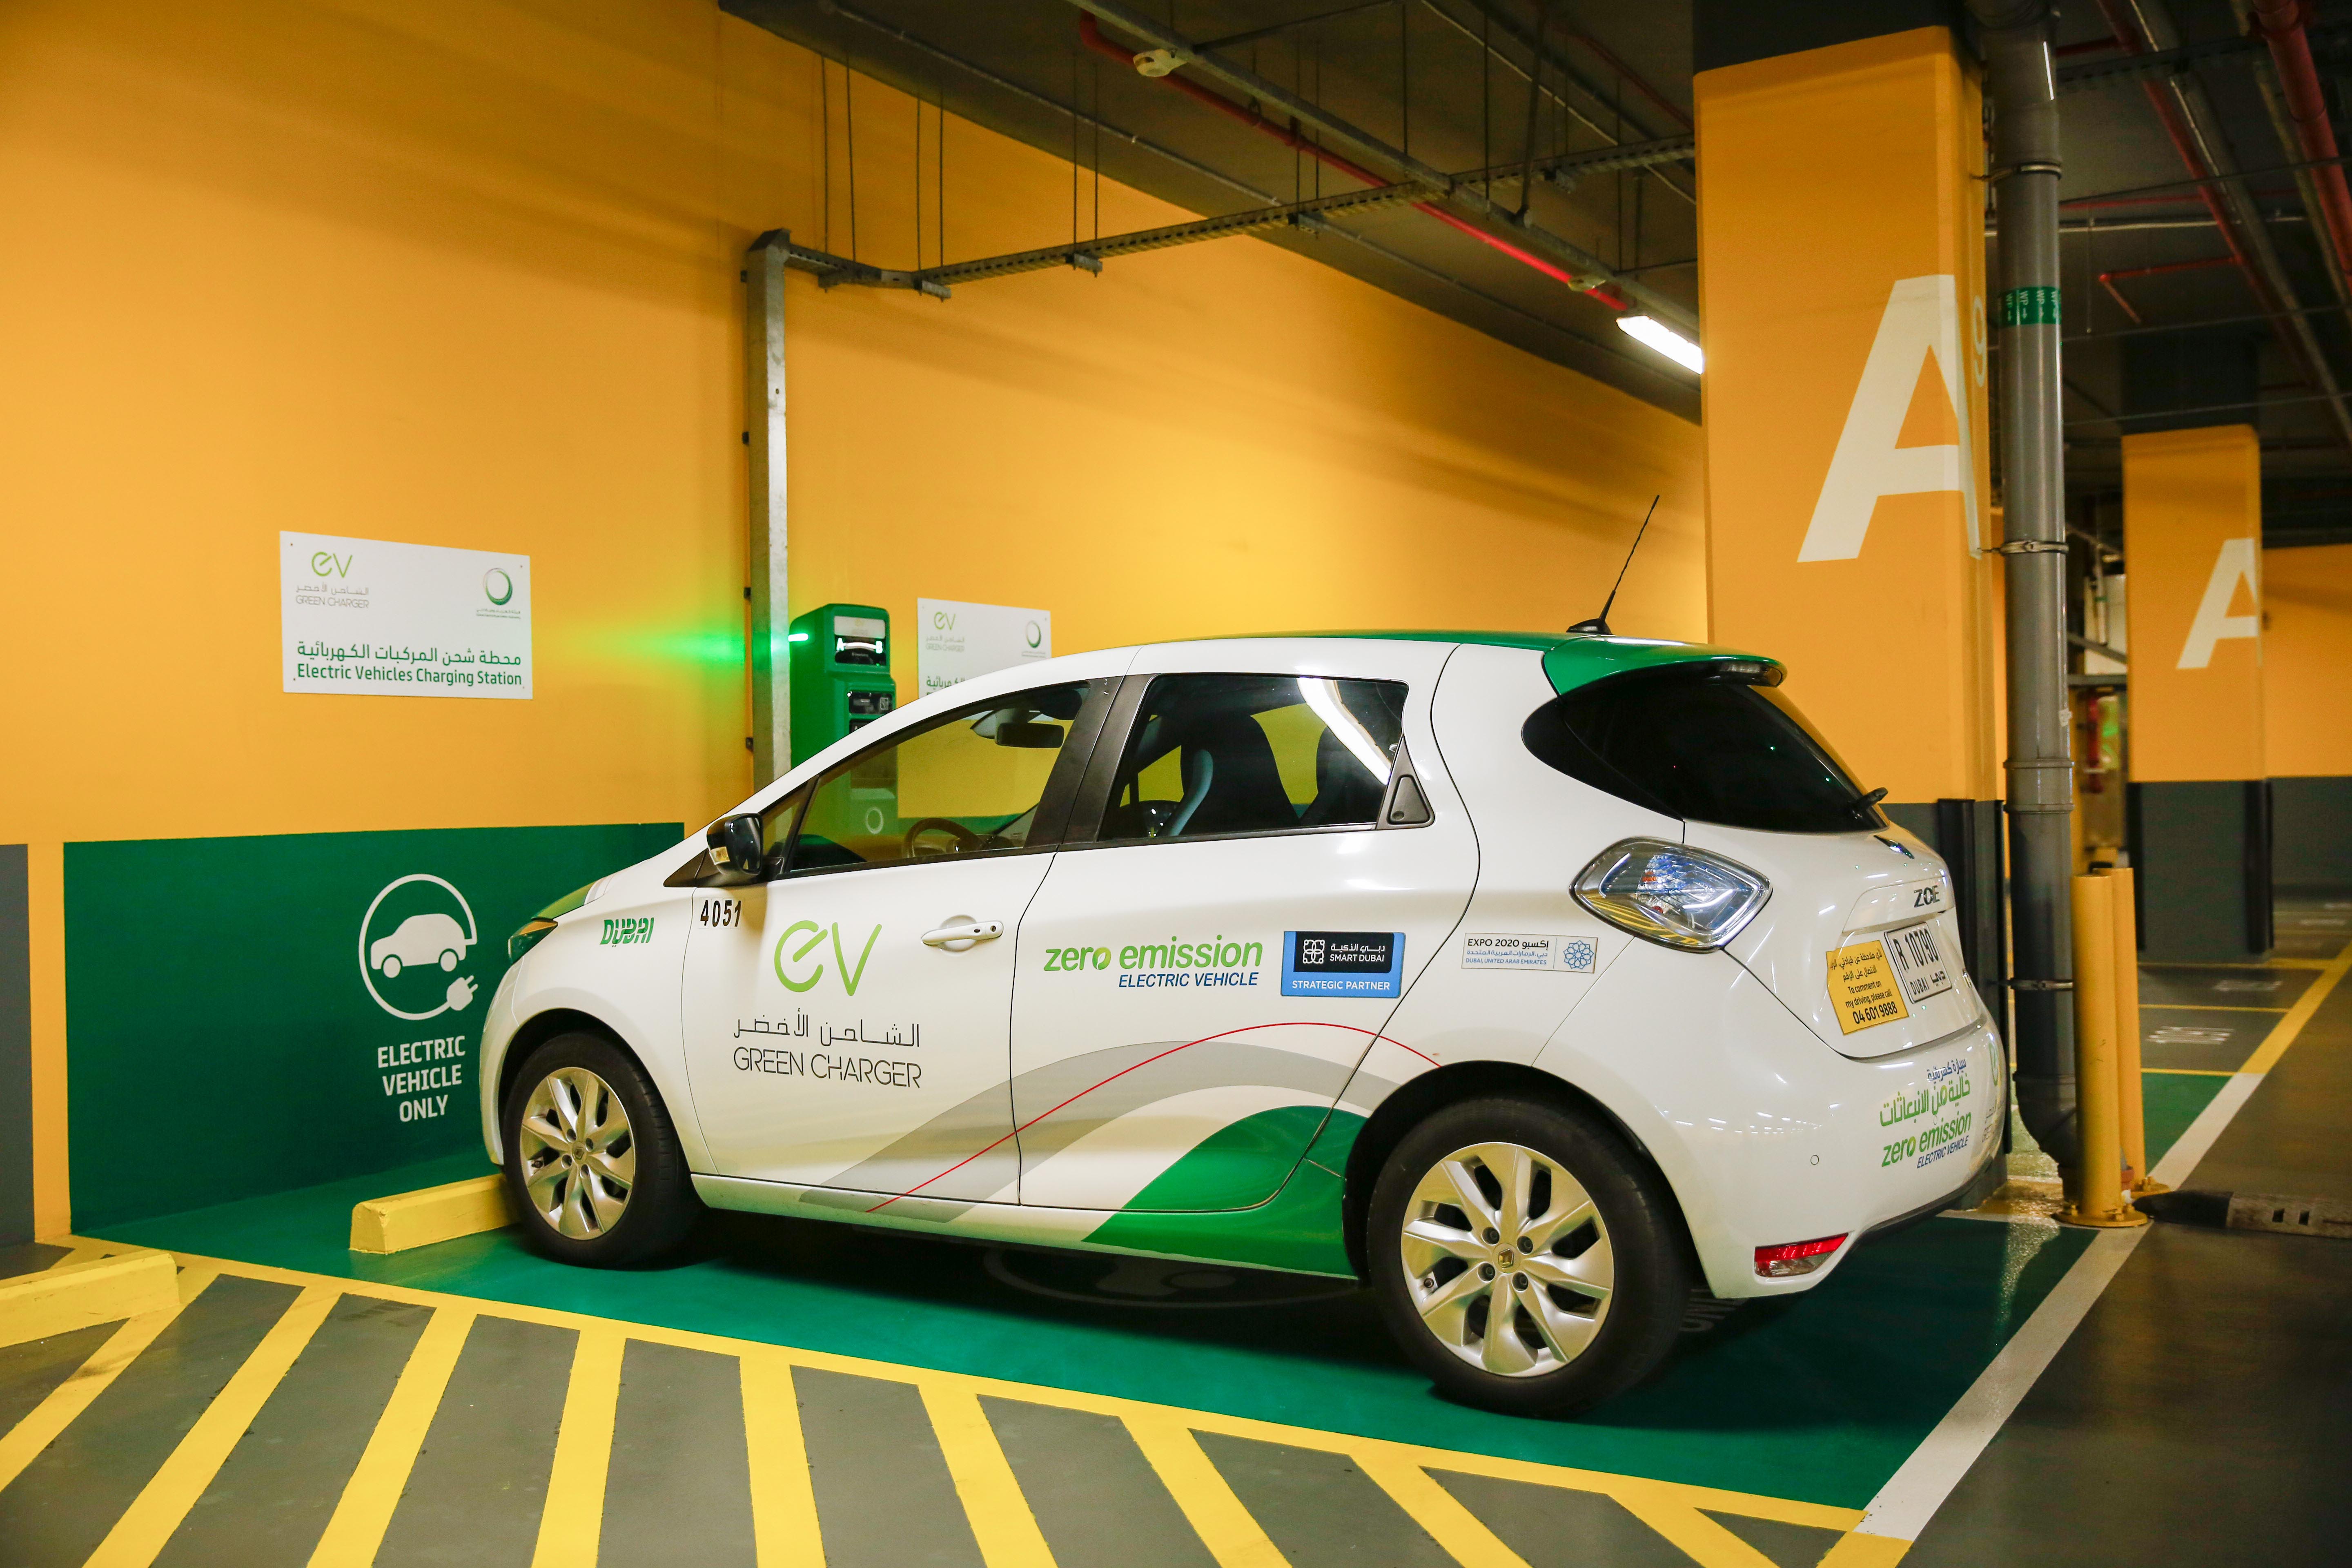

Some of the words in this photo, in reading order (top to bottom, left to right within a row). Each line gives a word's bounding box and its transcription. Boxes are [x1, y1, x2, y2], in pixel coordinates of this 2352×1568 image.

[1797, 274, 1982, 561] A
[296, 595, 325, 605] GREEN
[327, 597, 369, 608] CHARGER
[2176, 538, 2263, 670] A
[298, 641, 369, 661] الكهربائية
[375, 645, 437, 664] المركبات
[443, 648, 474, 666] شحن
[480, 650, 521, 665] محطة
[298, 663, 352, 679] Electric
[355, 665, 412, 681] Vehicles
[416, 668, 473, 686] Charging
[478, 671, 521, 685] Station
[1914, 885, 1940, 908] ZOE
[700, 900, 742, 927] 4051
[1043, 946, 1111, 971] zero
[1119, 935, 1263, 970] emission
[1331, 943, 1358, 953] الذكية
[1360, 945, 1385, 953] دبي
[1522, 940, 1549, 951] إكسبو
[1893, 938, 1909, 971] R
[1904, 928, 1938, 967] 10790
[1119, 973, 1189, 988] ELECTRIC
[1194, 972, 1259, 986] VEHICLE
[1292, 980, 1343, 989] STRATEGIC
[1346, 981, 1390, 990] PARTNER
[1855, 981, 1876, 993] comment
[1910, 977, 1929, 995] DUBAI
[1845, 1000, 1854, 1008] my
[1854, 996, 1872, 1005] driving,
[1871, 992, 1885, 1003] please
[1884, 989, 1893, 998] call
[734, 1007, 809, 1038] الأخضر
[1853, 1010, 1865, 1024] 04
[1865, 1006, 1880, 1021] 601
[1878, 1001, 1898, 1017] 9888
[820, 1019, 920, 1047] الشاحن
[378, 1036, 466, 1068] ELECTRIC
[734, 1046, 804, 1077] GREEN
[811, 1054, 922, 1089] CHARGER
[383, 1064, 462, 1096] VEHICLE
[1949, 1073, 1970, 1107] خالية
[399, 1094, 448, 1123] ONLY
[1882, 1136, 1916, 1167] zero
[1919, 1111, 1971, 1153] emission
[1917, 1146, 1946, 1169] ELECTRIC
[1947, 1135, 1969, 1155] VEHICLE
